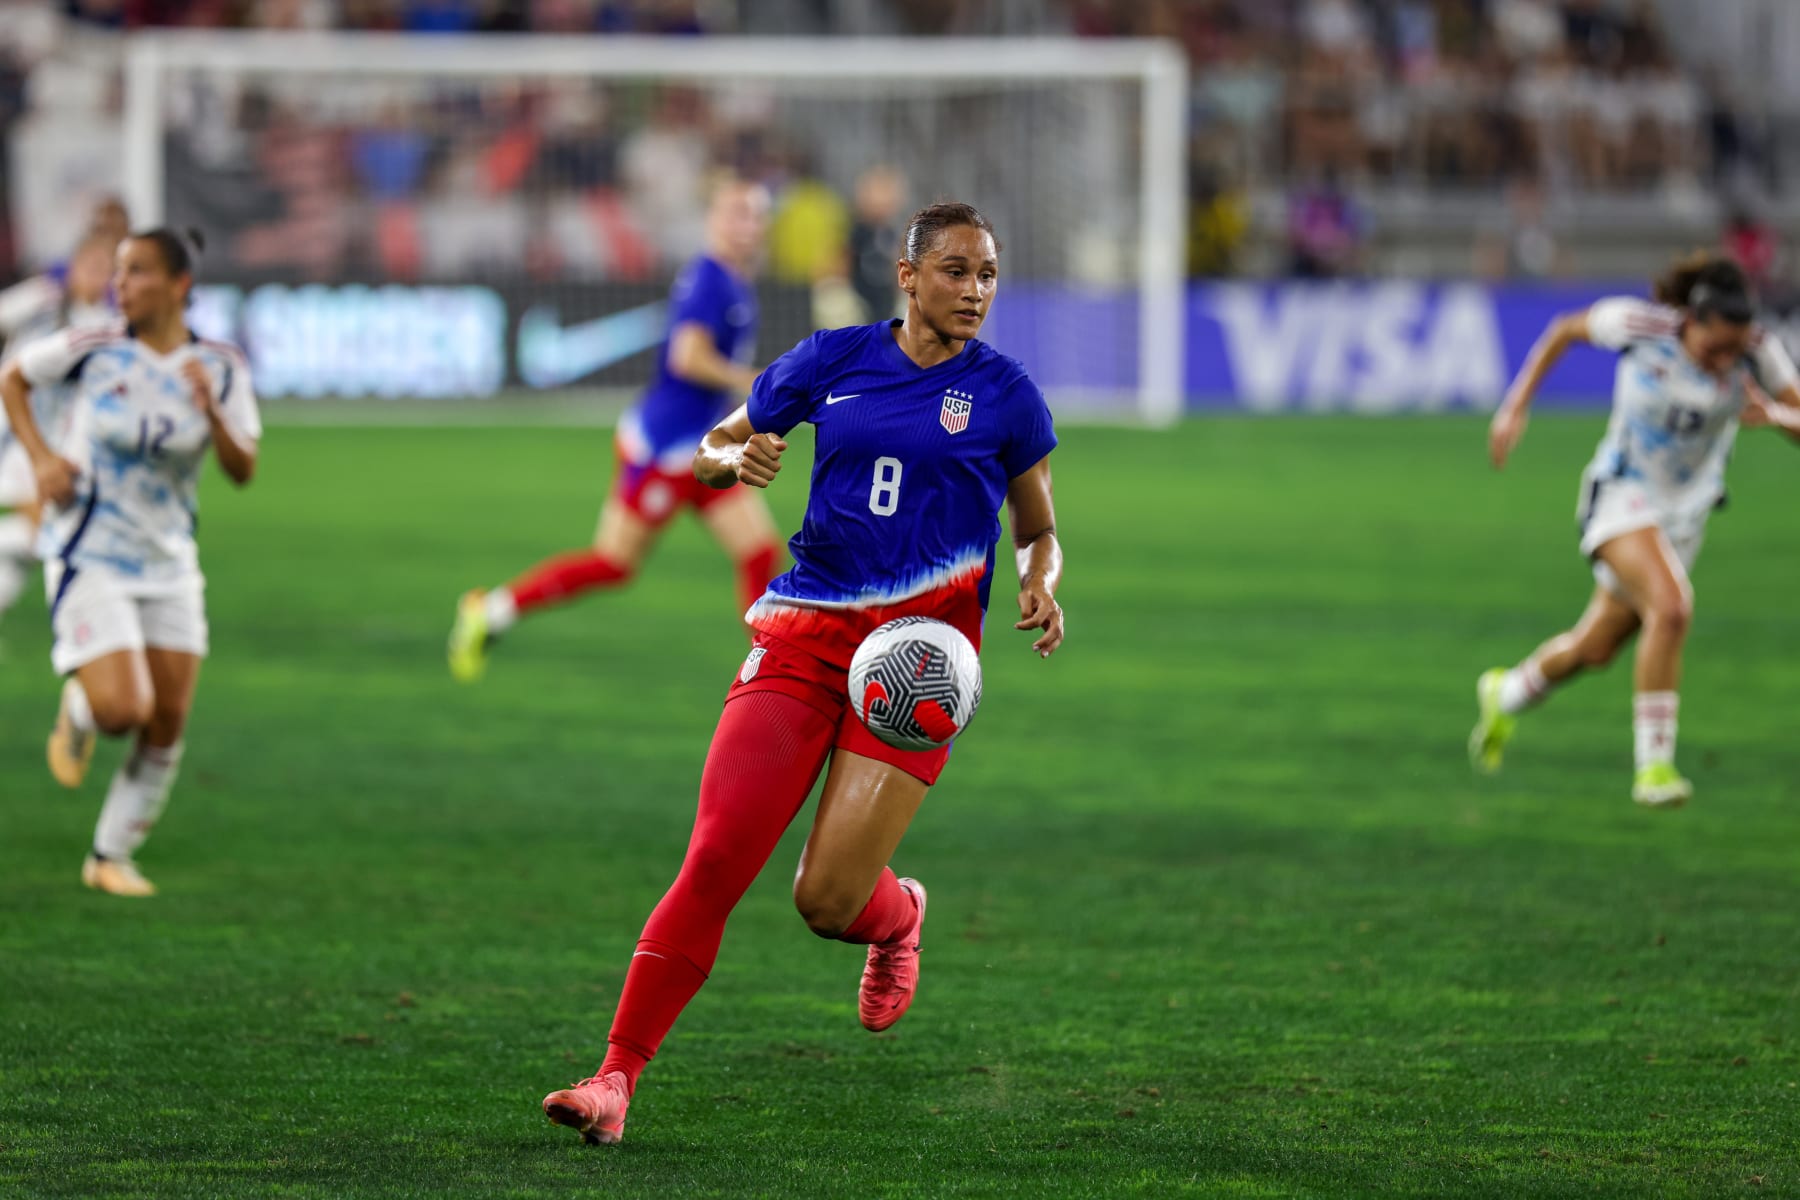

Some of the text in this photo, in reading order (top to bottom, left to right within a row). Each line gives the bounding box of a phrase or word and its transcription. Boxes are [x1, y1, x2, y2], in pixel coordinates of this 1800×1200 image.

[1216, 283, 1507, 409] VISA
[944, 398, 970, 414] USA
[138, 412, 177, 459] 12
[868, 456, 903, 517] 8
